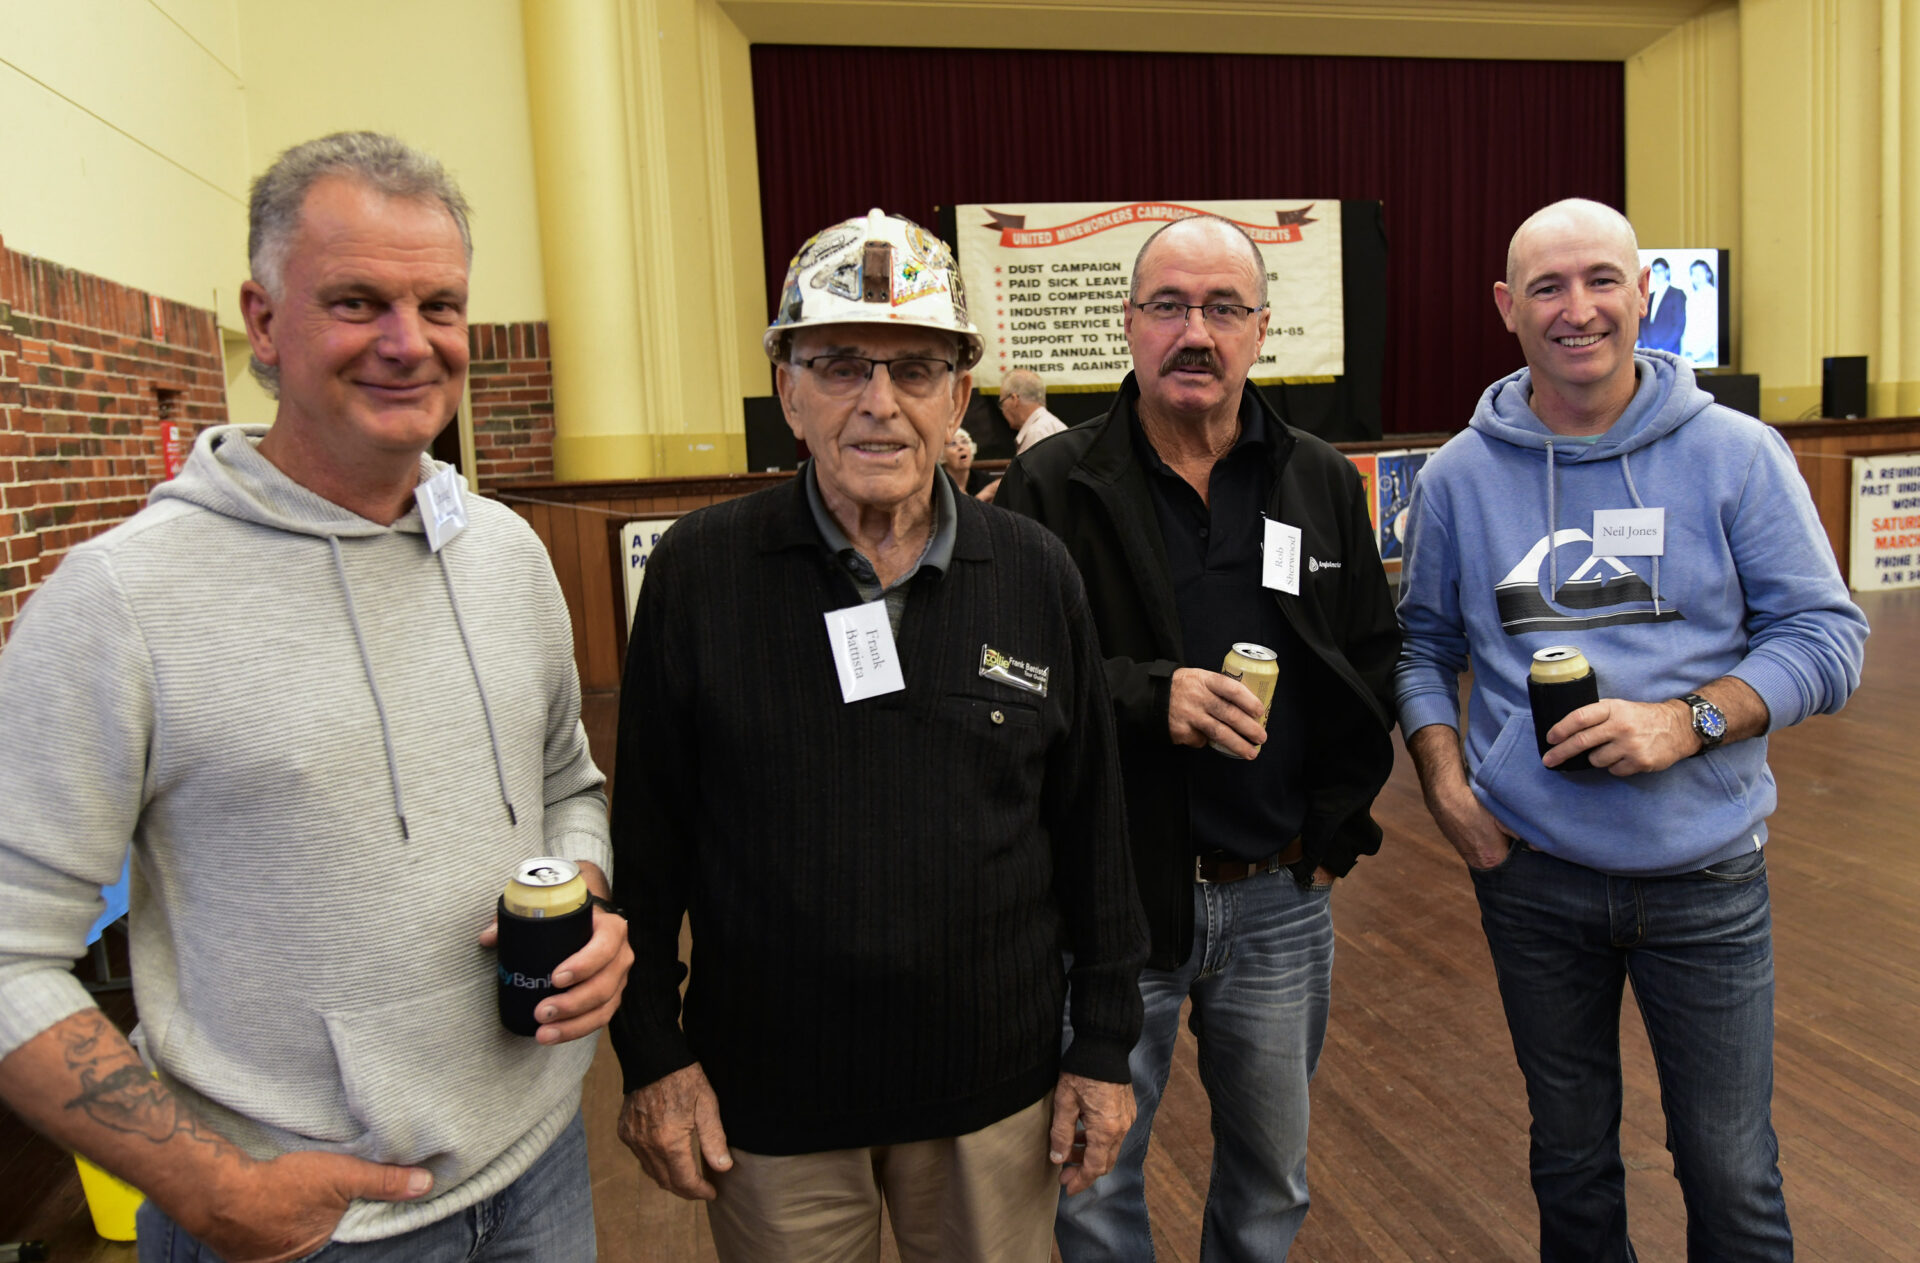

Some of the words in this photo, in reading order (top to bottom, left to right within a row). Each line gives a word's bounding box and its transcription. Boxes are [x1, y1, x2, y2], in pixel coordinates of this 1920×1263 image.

[1012, 231, 1052, 246] UNITED
[1056, 208, 1133, 242] MINEWORKERS
[1136, 205, 1199, 220] CAMPAIGN
[1009, 264, 1044, 274] DUST
[1051, 262, 1121, 273] CAMPAIGN
[1009, 279, 1041, 289] PAID
[1048, 278, 1078, 287] SICK
[1086, 276, 1129, 287] LEAVE
[1009, 293, 1042, 302] PAID
[1048, 290, 1130, 301] COMPENSAT
[1010, 306, 1077, 317] INDUSTRY
[1085, 305, 1124, 315] PENSI
[1011, 321, 1047, 331] LONG
[1053, 319, 1110, 329] SERVICE
[1011, 334, 1074, 345] SUPPORT
[1081, 334, 1099, 343] TO
[1012, 350, 1043, 359] PAID
[1051, 347, 1106, 357] ANNUAL
[1072, 360, 1130, 371] AGAINST
[1860, 484, 1891, 497] PAST
[1602, 525, 1625, 537] Neil
[1625, 525, 1658, 540] Jones
[632, 535, 642, 548] A
[1274, 546, 1285, 568] Rob
[1286, 535, 1297, 587] Sherwood
[845, 629, 864, 680] Battista
[866, 629, 886, 670] Frank
[1008, 656, 1025, 670] Frank
